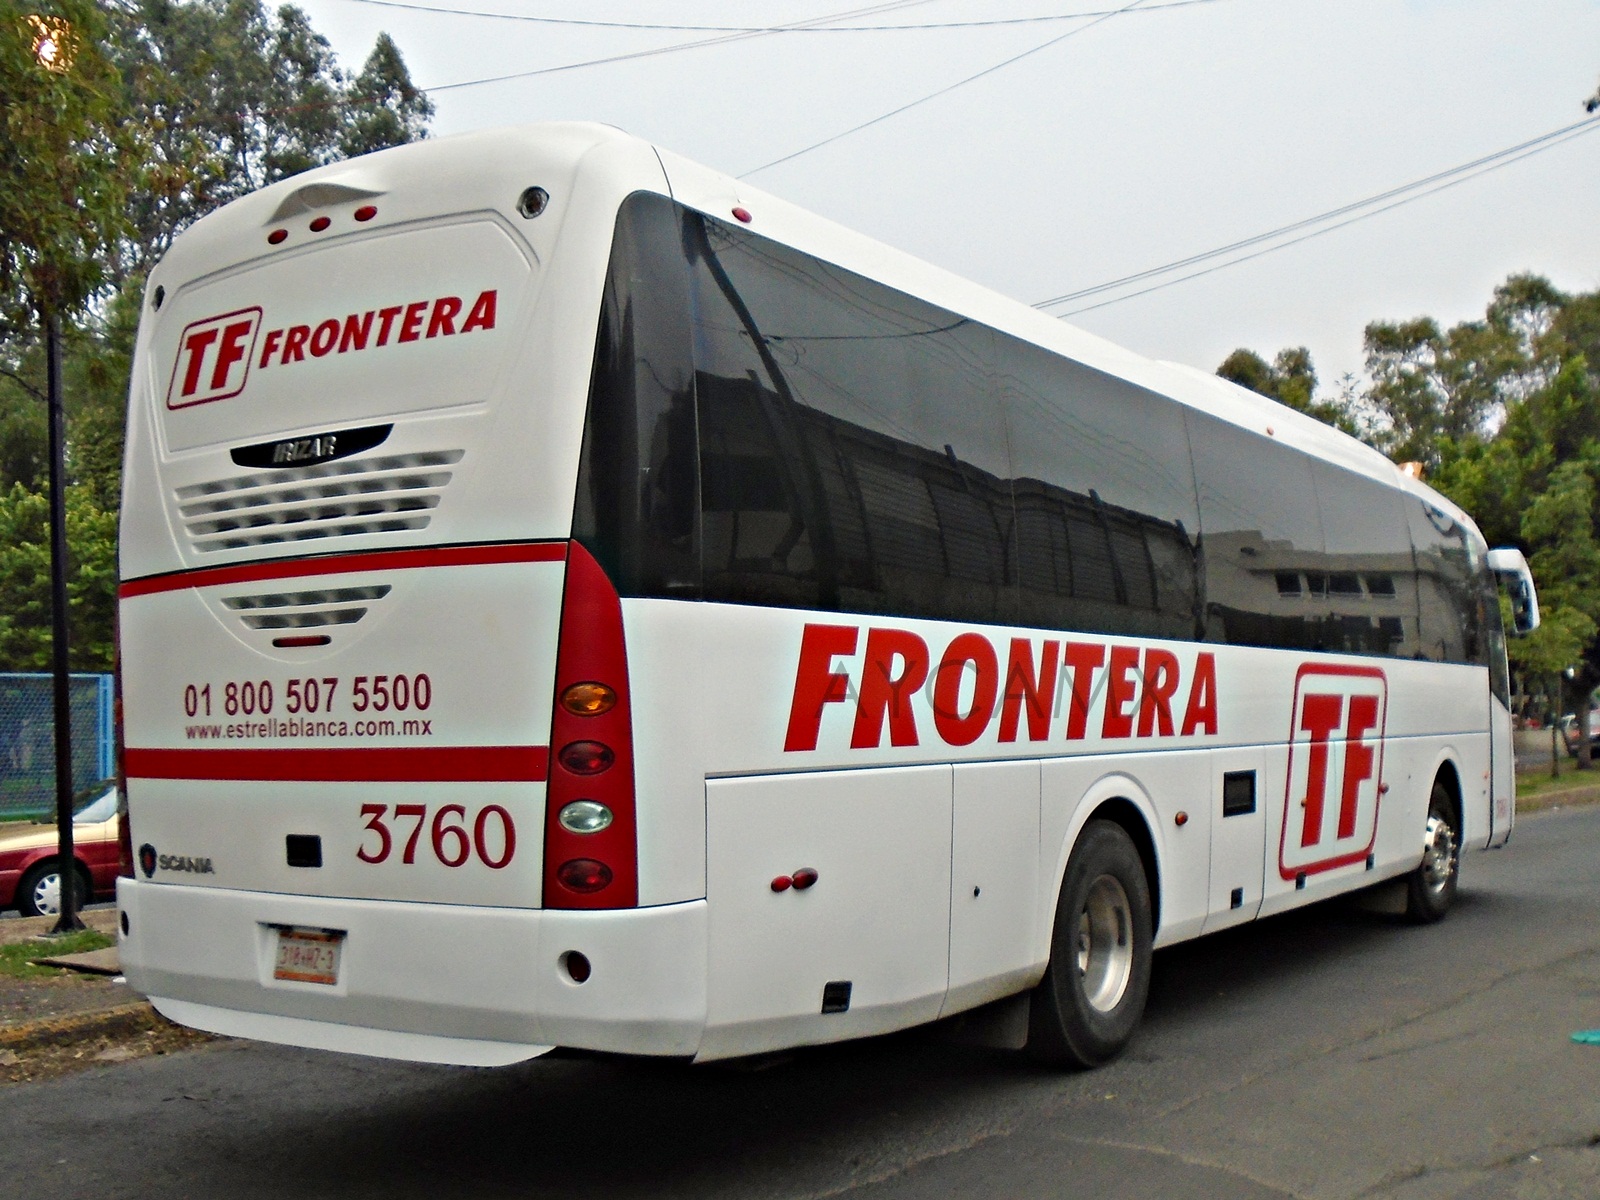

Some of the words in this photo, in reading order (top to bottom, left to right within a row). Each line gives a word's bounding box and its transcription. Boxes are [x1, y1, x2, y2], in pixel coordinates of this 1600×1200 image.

[180, 318, 253, 397] TF
[259, 289, 498, 369] FRONTERA
[273, 435, 337, 463] IRIZAR
[184, 684, 211, 717] 01
[224, 680, 274, 716] 800
[286, 677, 340, 713] 507
[352, 673, 433, 712] 5500
[783, 622, 1218, 752] FRONTERA
[185, 716, 433, 740] www.estrellablanca.com.mx
[1301, 694, 1379, 848] TF
[356, 803, 517, 870] 3760
[159, 854, 216, 875] SCANIA
